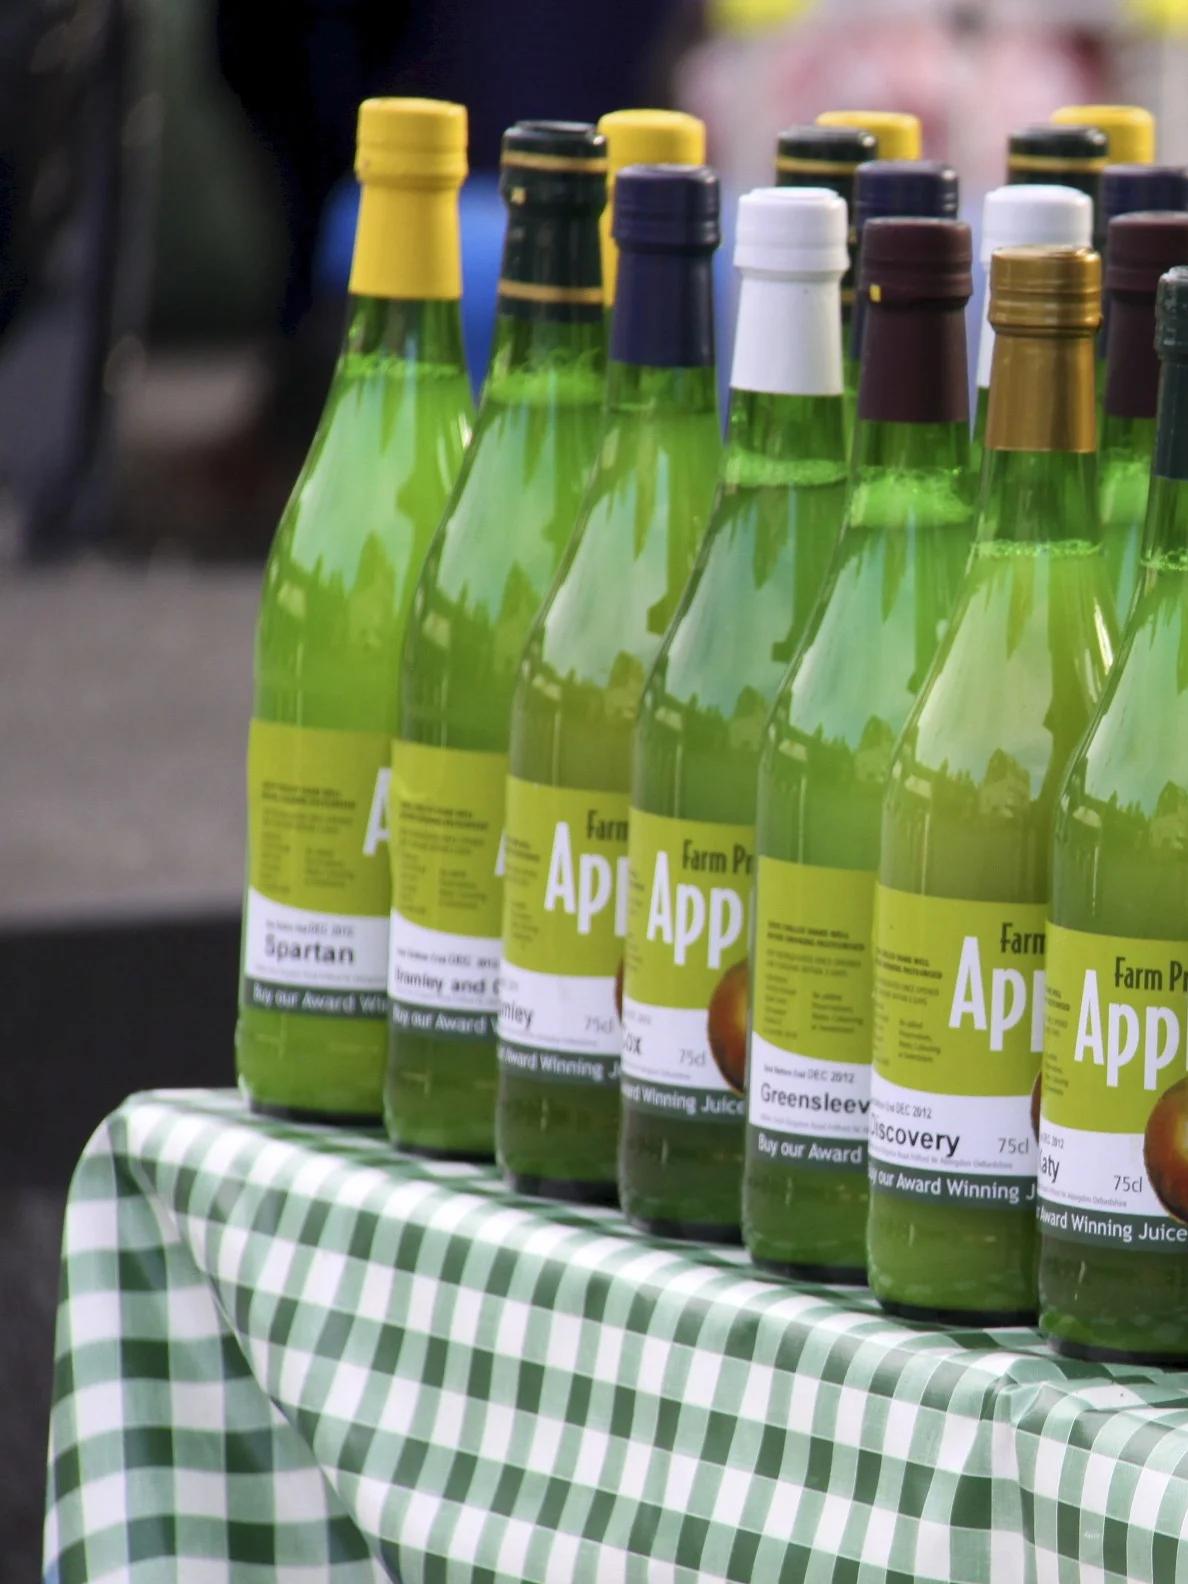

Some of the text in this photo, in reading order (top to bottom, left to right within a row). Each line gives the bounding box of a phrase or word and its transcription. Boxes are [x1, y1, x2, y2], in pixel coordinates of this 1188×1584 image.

[682, 839, 728, 873] Farm
[264, 932, 355, 965] Spartan
[450, 978, 485, 995] and
[1114, 956, 1163, 992] Farm
[275, 989, 299, 1008] our
[302, 991, 357, 1015] Award
[434, 1012, 489, 1036] Award
[584, 1016, 615, 1035] 75cl
[539, 1054, 605, 1085] Winning
[679, 1047, 707, 1068] 75cl
[807, 1068, 828, 1080] DEC
[830, 1071, 855, 1084] 2012
[640, 1087, 698, 1115] Winning
[912, 1104, 932, 1119] 2012
[758, 1132, 779, 1157] Buy
[780, 1141, 806, 1158] our
[807, 1142, 863, 1165] Award
[997, 1137, 1030, 1155] 75cl
[1040, 1147, 1143, 1193] aty 75cl
[896, 1172, 942, 1195] Award
[946, 1178, 1020, 1204] Winning
[1040, 1204, 1188, 1244] Award Winning Juice
